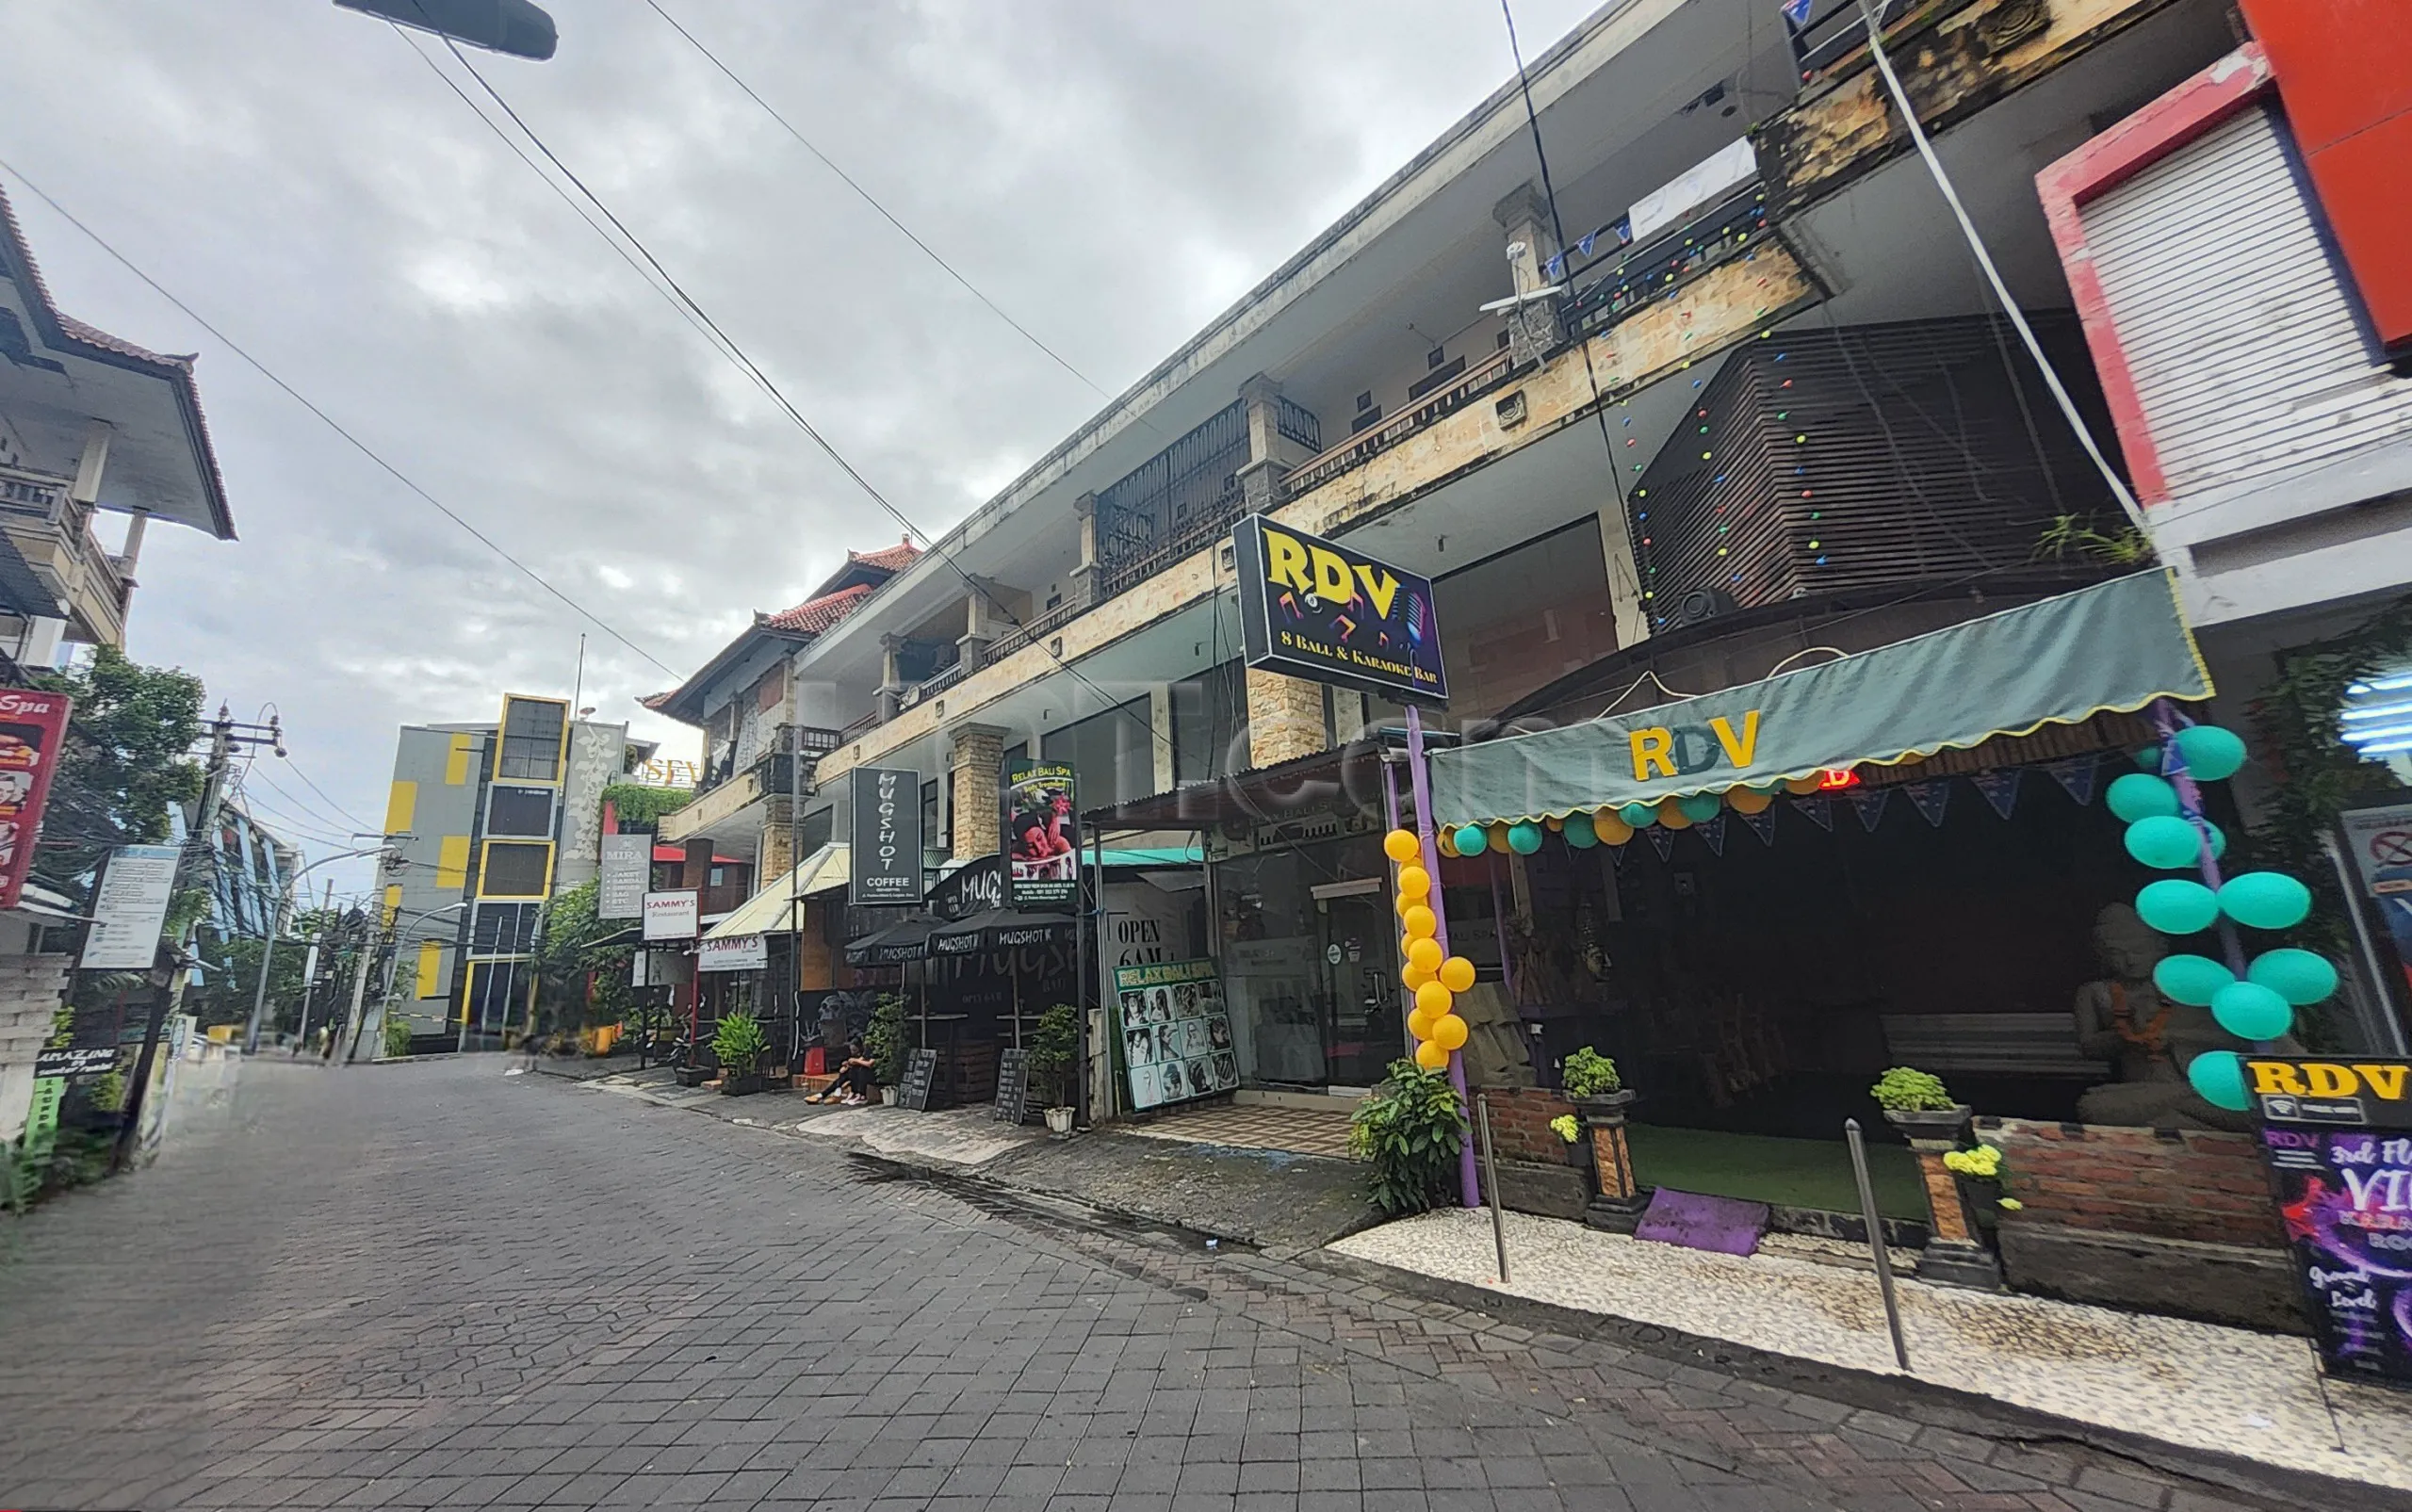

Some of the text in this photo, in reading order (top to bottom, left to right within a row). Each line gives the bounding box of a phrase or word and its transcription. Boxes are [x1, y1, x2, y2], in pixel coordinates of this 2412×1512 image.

[1262, 528, 1400, 620] RDV
[1280, 630, 1293, 646] 8
[1336, 645, 1349, 660] &
[0, 694, 50, 715] Spa
[1628, 709, 1760, 782] RDV
[1011, 765, 1071, 784] RELAX BALI SPA
[878, 772, 897, 871] MUGSHOT
[606, 851, 644, 860] MIRA
[867, 877, 909, 887] COFFEE
[646, 900, 695, 909] SAMMY'S
[999, 930, 1043, 945] MUGSHOT
[1117, 919, 1161, 943] OPEN
[707, 935, 758, 952] SAMMY'S
[937, 935, 974, 952] MUGSHOT
[1117, 967, 1162, 987] RELAX
[2247, 1062, 2410, 1100] RDV
[2264, 1130, 2321, 1148] RDV
